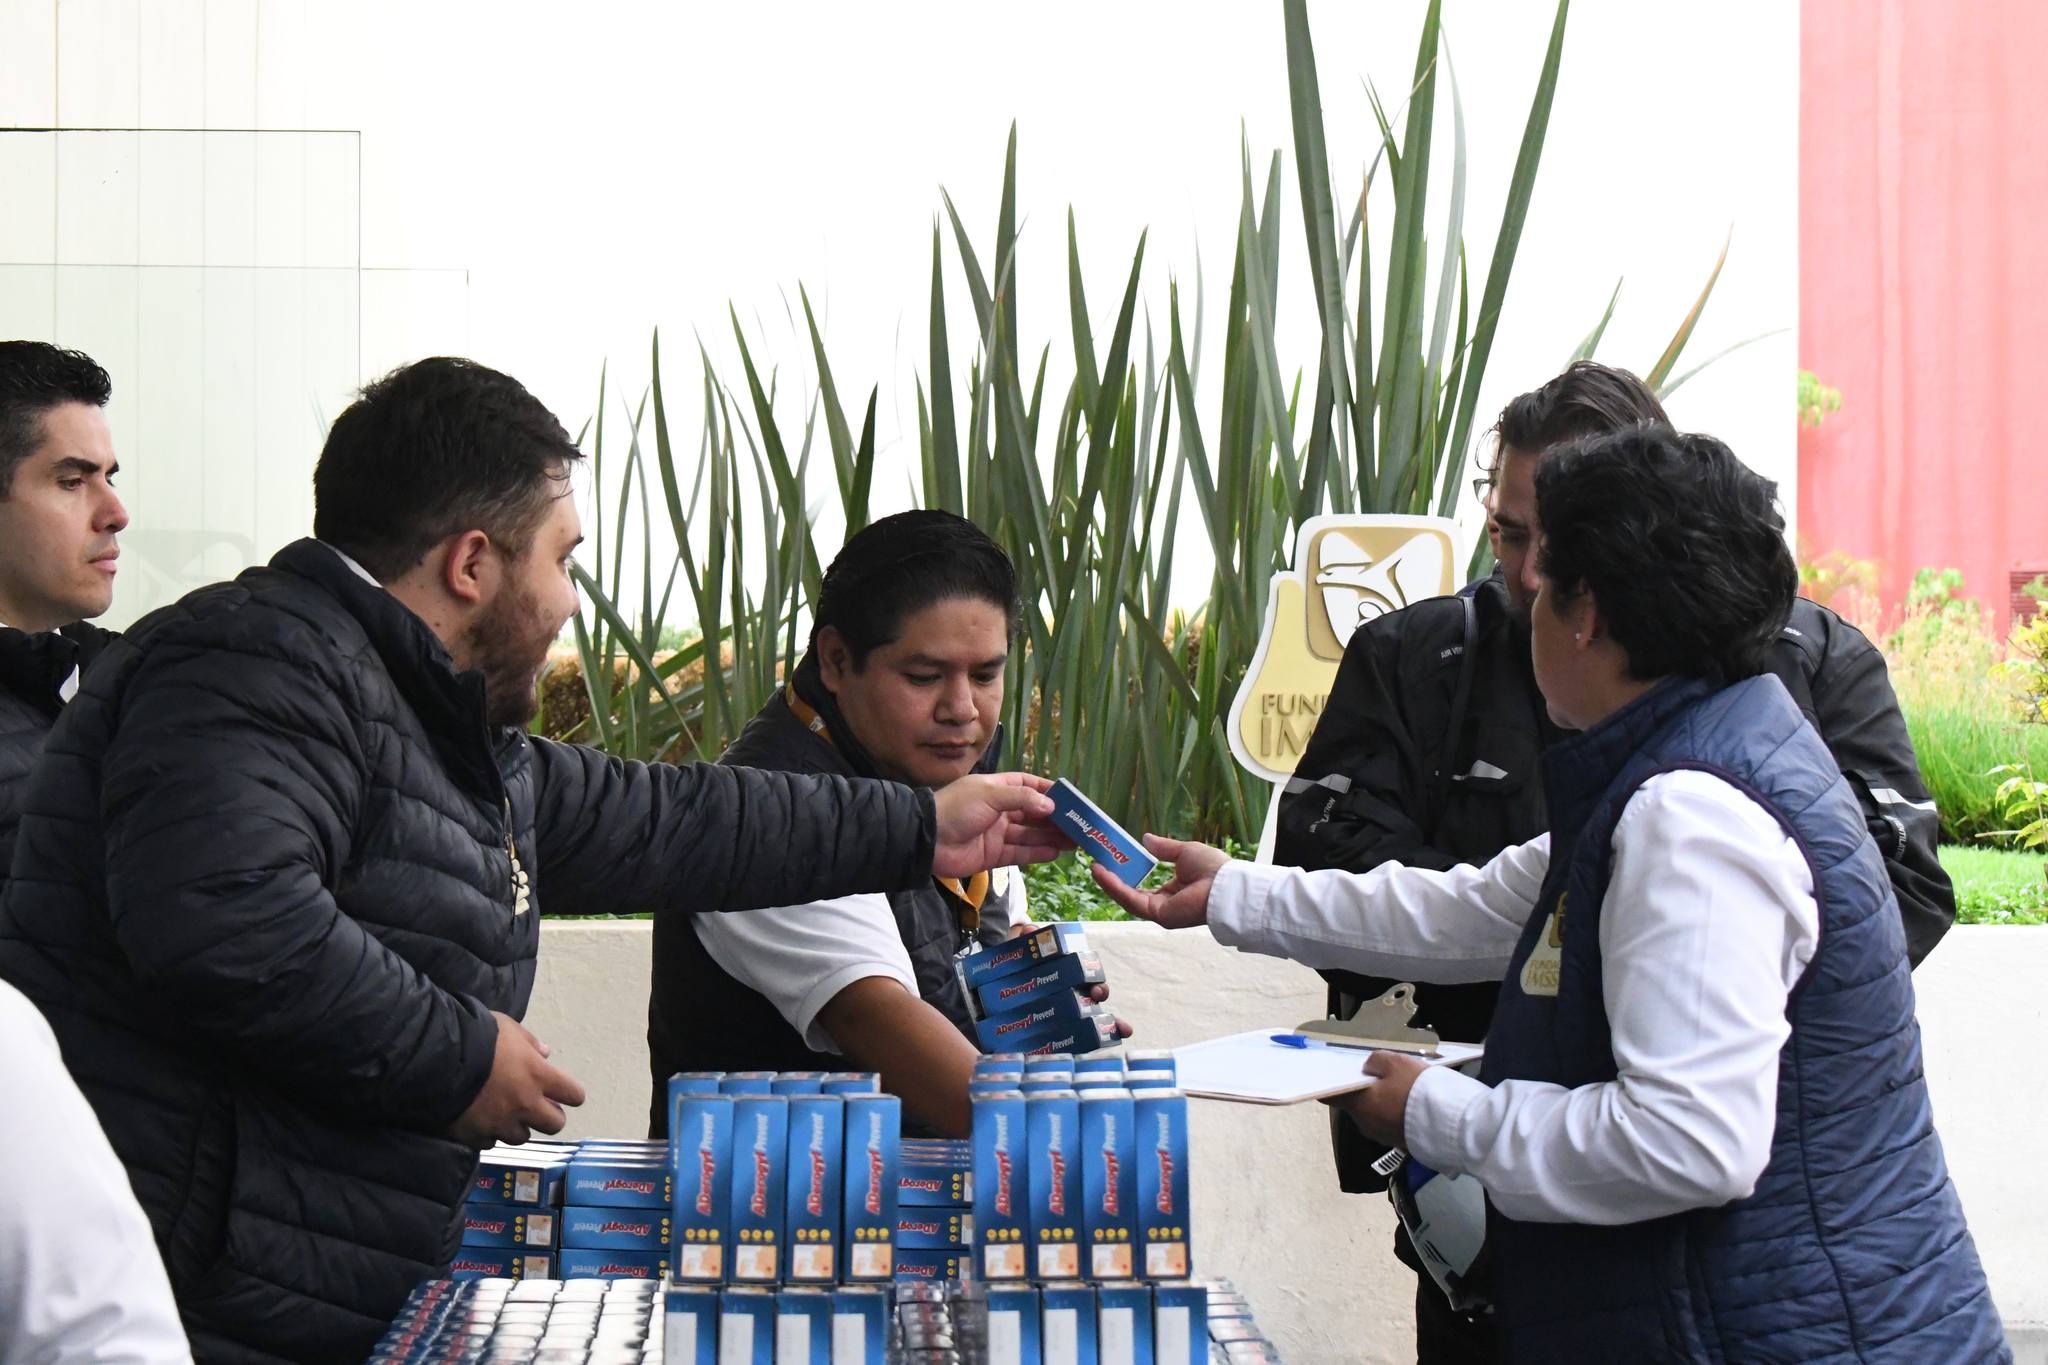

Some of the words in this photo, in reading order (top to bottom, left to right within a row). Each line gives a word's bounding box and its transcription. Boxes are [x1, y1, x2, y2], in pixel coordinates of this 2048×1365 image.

[1260, 716, 1318, 757] IM
[1065, 809, 1092, 833] Prevent
[1036, 970, 1058, 986] Prevent
[1032, 1007, 1055, 1023] Prevent
[1051, 1035, 1074, 1053] Prevent
[701, 1112, 714, 1150] Prevent
[755, 1112, 768, 1151] Prevent
[810, 1111, 825, 1151] Prevent
[869, 1111, 882, 1150] Prevent
[995, 1113, 1008, 1151] Prevent
[1047, 1112, 1062, 1151] Prevent
[1103, 1112, 1116, 1150] Prevent
[1156, 1112, 1170, 1150] Prevent
[575, 1179, 606, 1191] Prevent
[571, 1220, 604, 1233] Prevent
[570, 1263, 601, 1275] Prevent
